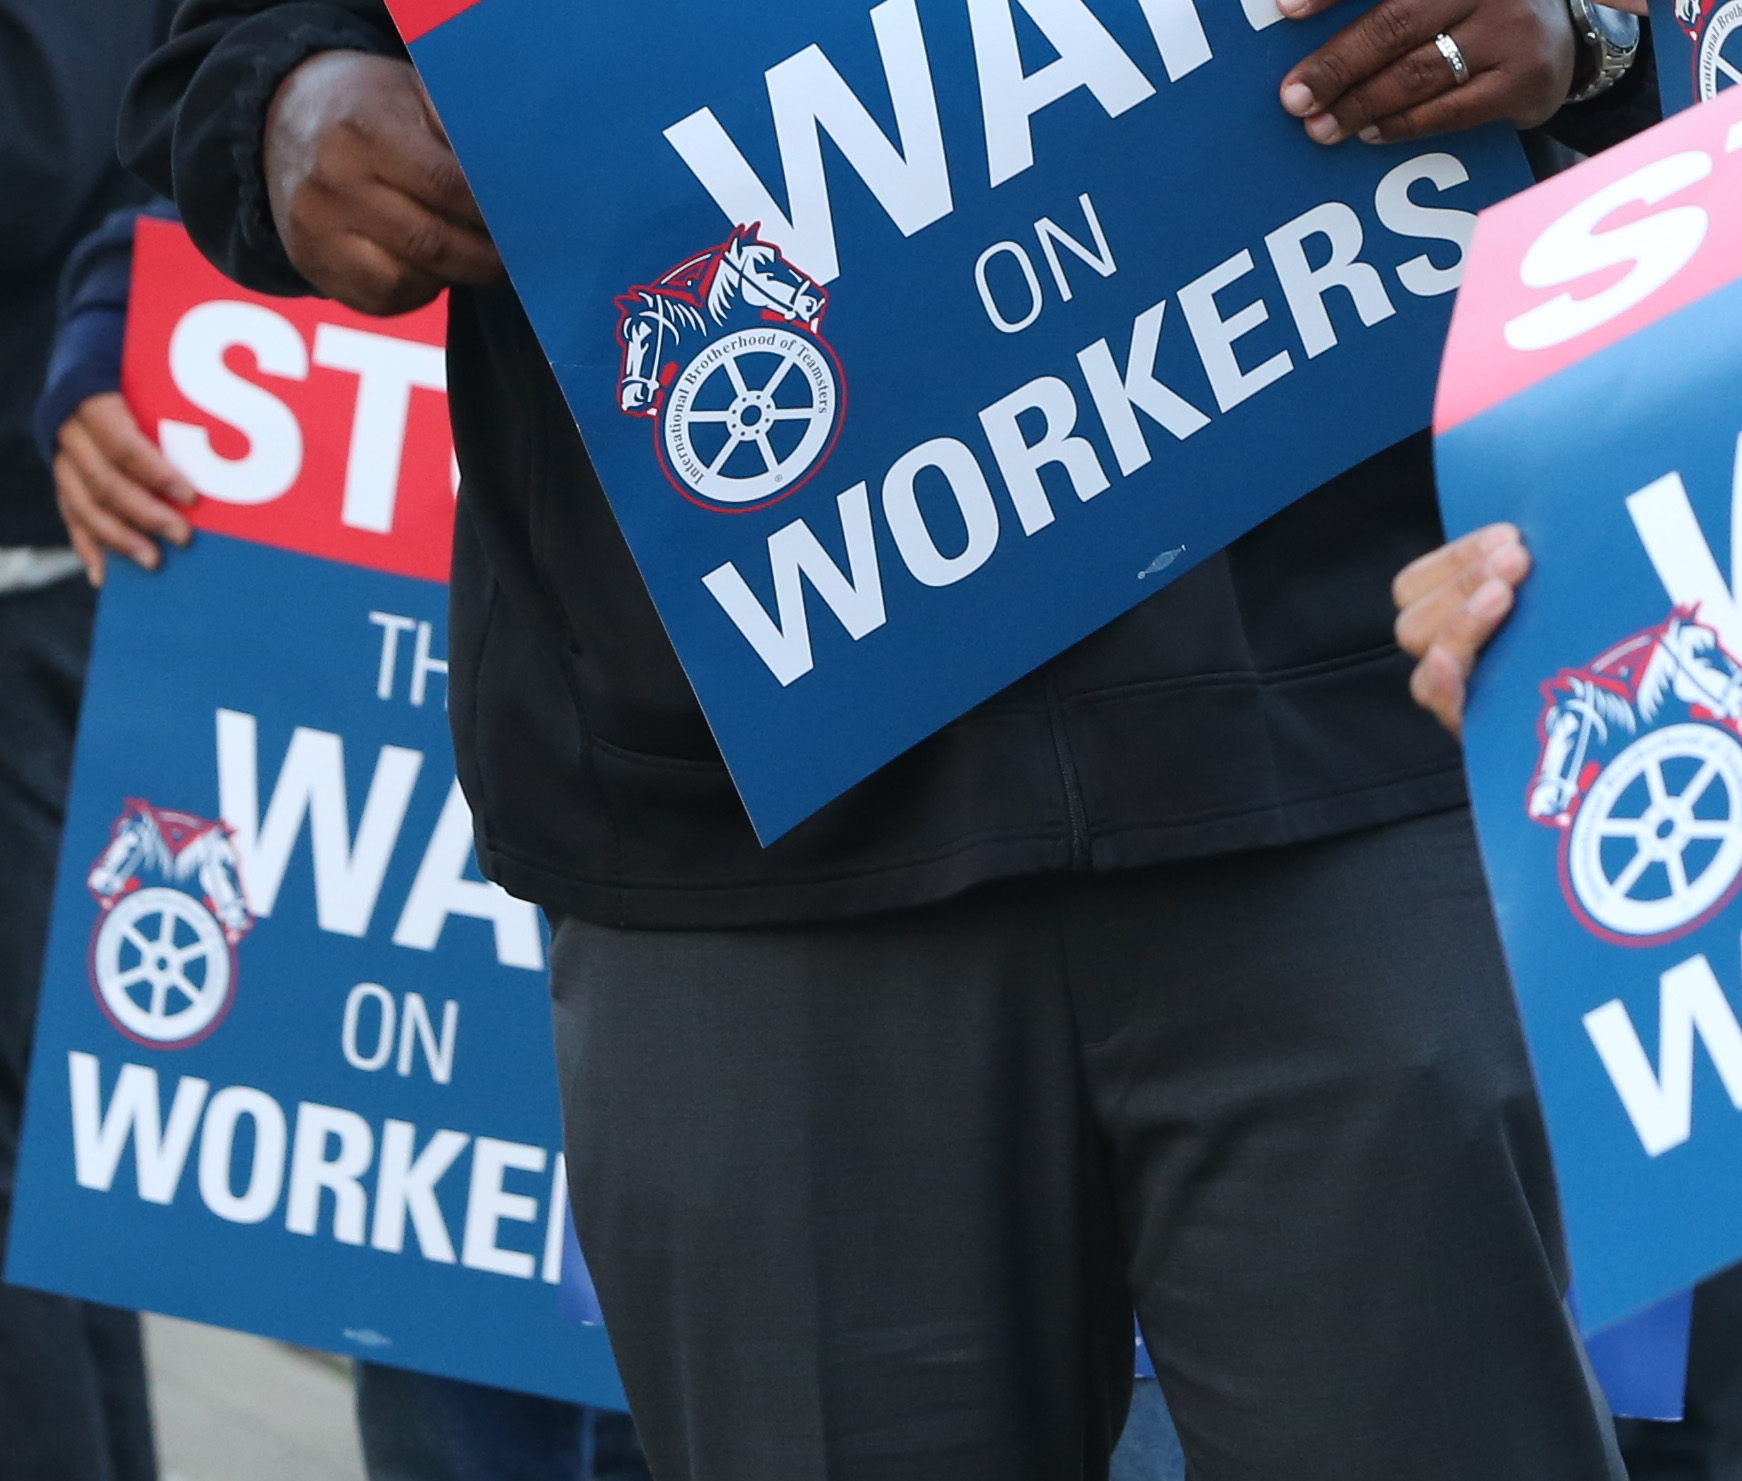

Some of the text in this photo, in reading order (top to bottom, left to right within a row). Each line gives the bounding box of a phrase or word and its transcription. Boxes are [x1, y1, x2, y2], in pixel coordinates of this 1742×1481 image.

[974, 192, 1118, 334] ON
[669, 333, 828, 486] International Brotherhood of Teamsters
[700, 151, 1480, 688] WORKERS
[367, 611, 448, 708] TH
[214, 707, 547, 972] WA
[341, 981, 460, 1086] ON
[67, 1049, 568, 1286] WORKE
